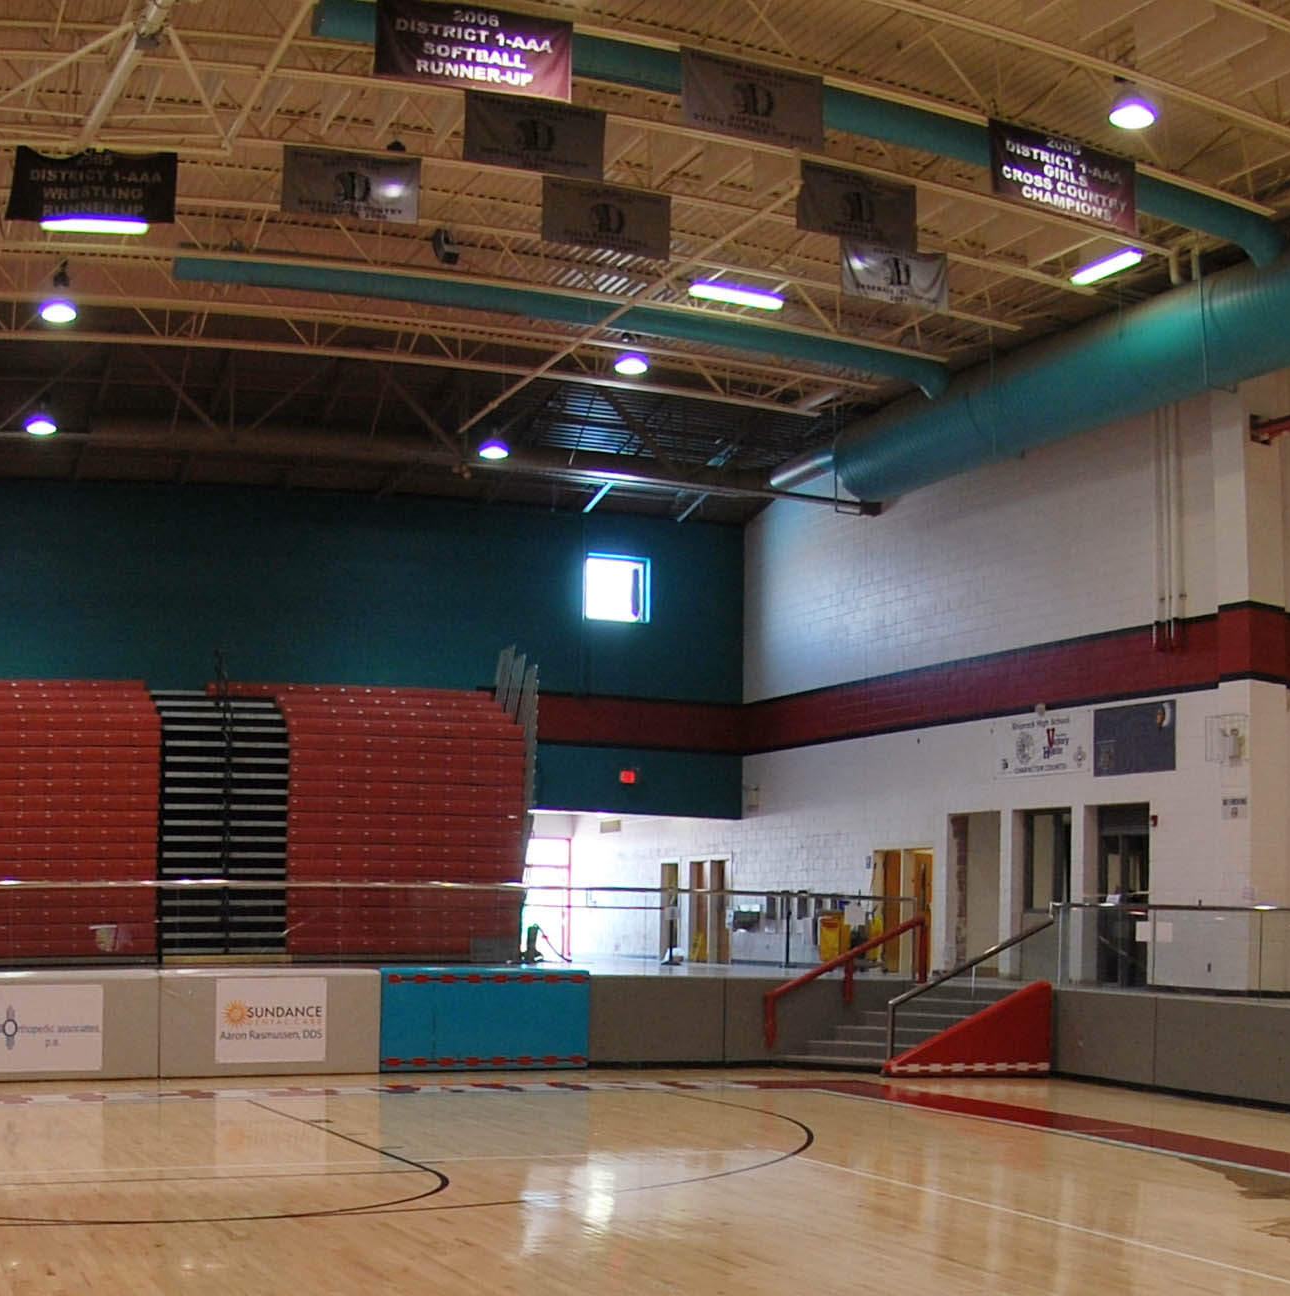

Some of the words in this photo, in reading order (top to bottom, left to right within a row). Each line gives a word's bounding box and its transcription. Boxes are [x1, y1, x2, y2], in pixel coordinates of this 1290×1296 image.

[453, 10, 499, 27] 2006
[396, 18, 489, 43] DISTRICT
[496, 33, 553, 54] 1-AAA
[423, 42, 526, 69] SOFTBALL
[416, 59, 533, 87] RUNNER-UP
[1005, 140, 1074, 170] DISTRICT
[29, 169, 107, 182] DISTRICT
[112, 170, 163, 183] 1-AAA
[1043, 164, 1089, 187] GIRLS
[43, 186, 144, 200] WRESTLING
[1002, 165, 1053, 190] CROSS
[1056, 183, 1127, 212] COUNTRY
[1021, 186, 1112, 222] CHAMPIONS
[247, 1006, 323, 1018] SUNDANCE
[220, 1031, 247, 1040] Aaron
[302, 1029, 322, 1039] DDS
